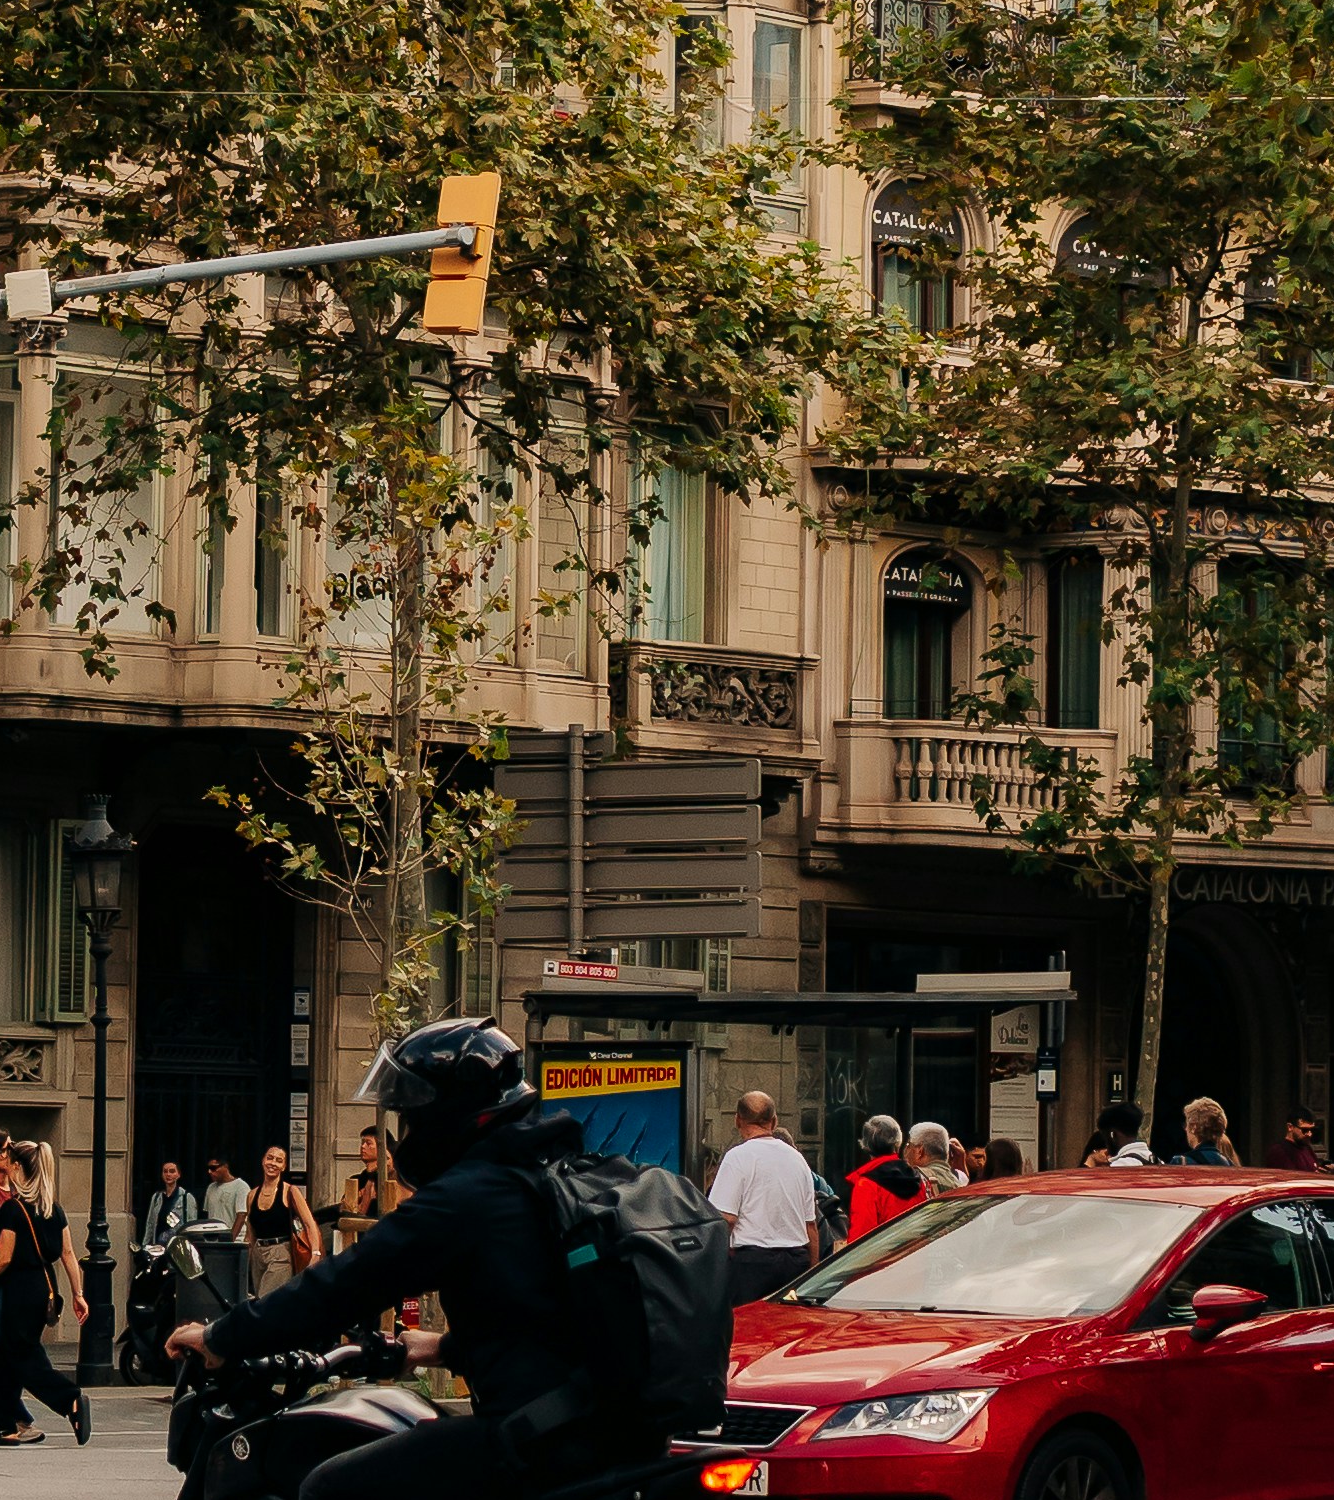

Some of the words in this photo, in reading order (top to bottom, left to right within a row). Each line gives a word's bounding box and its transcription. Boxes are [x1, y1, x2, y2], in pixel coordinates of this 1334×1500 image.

[1174, 869, 1313, 905] CATALONIA
[546, 1064, 603, 1091] EDICIÓN
[607, 1066, 677, 1086] LIMITADA
[1113, 1074, 1122, 1091] H
